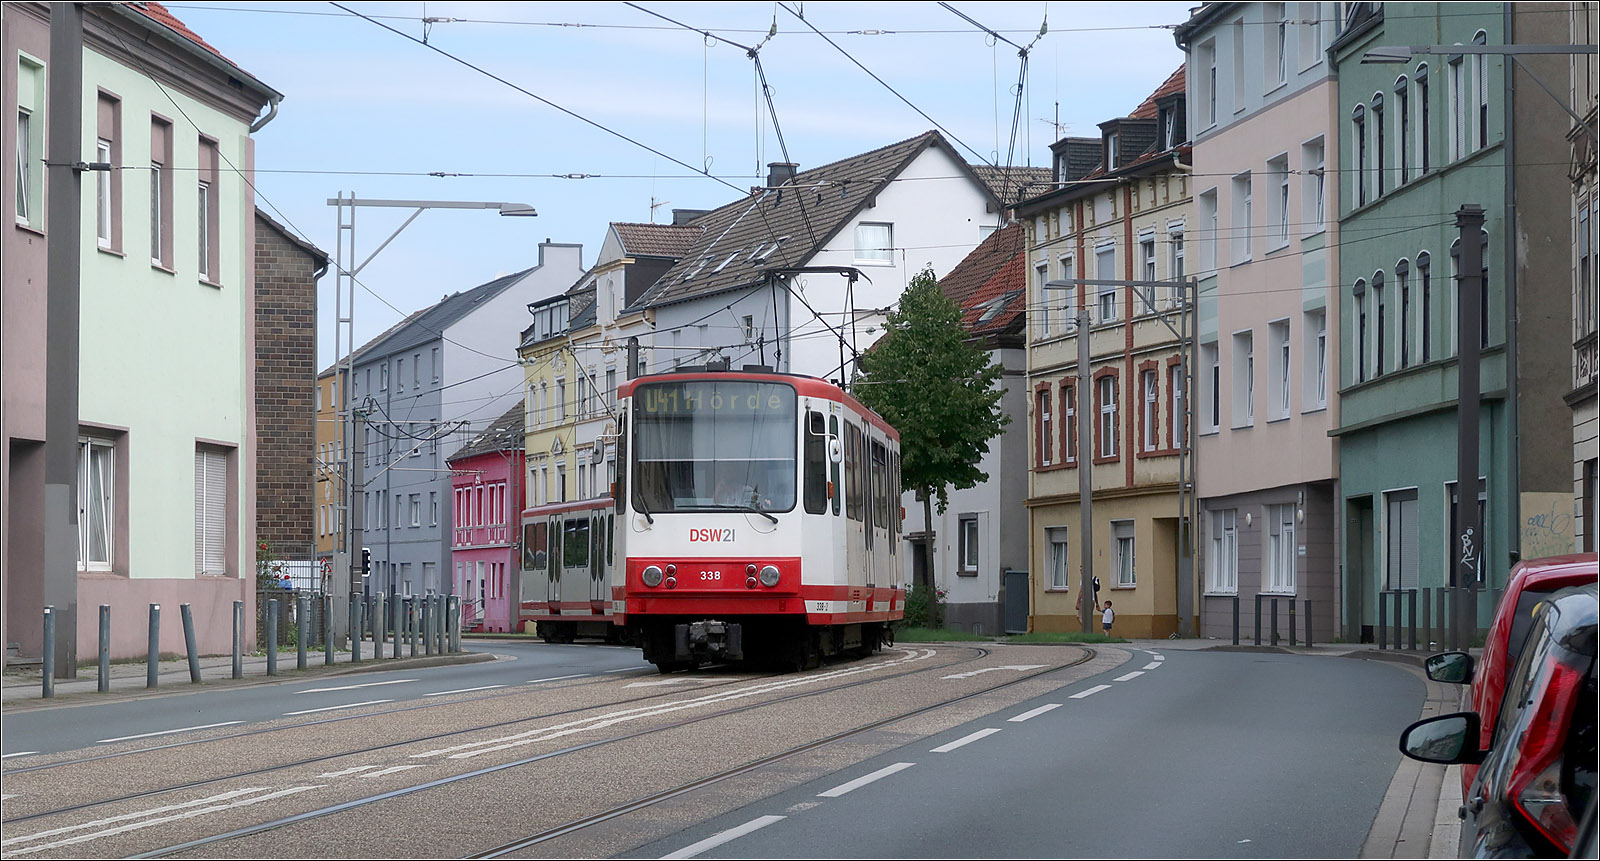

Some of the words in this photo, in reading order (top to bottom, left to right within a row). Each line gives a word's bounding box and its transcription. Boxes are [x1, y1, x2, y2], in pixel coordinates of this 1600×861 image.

[646, 388, 678, 412] U41
[686, 389, 782, 410] Hörde
[689, 528, 736, 543] DSW21
[700, 570, 721, 581] 338
